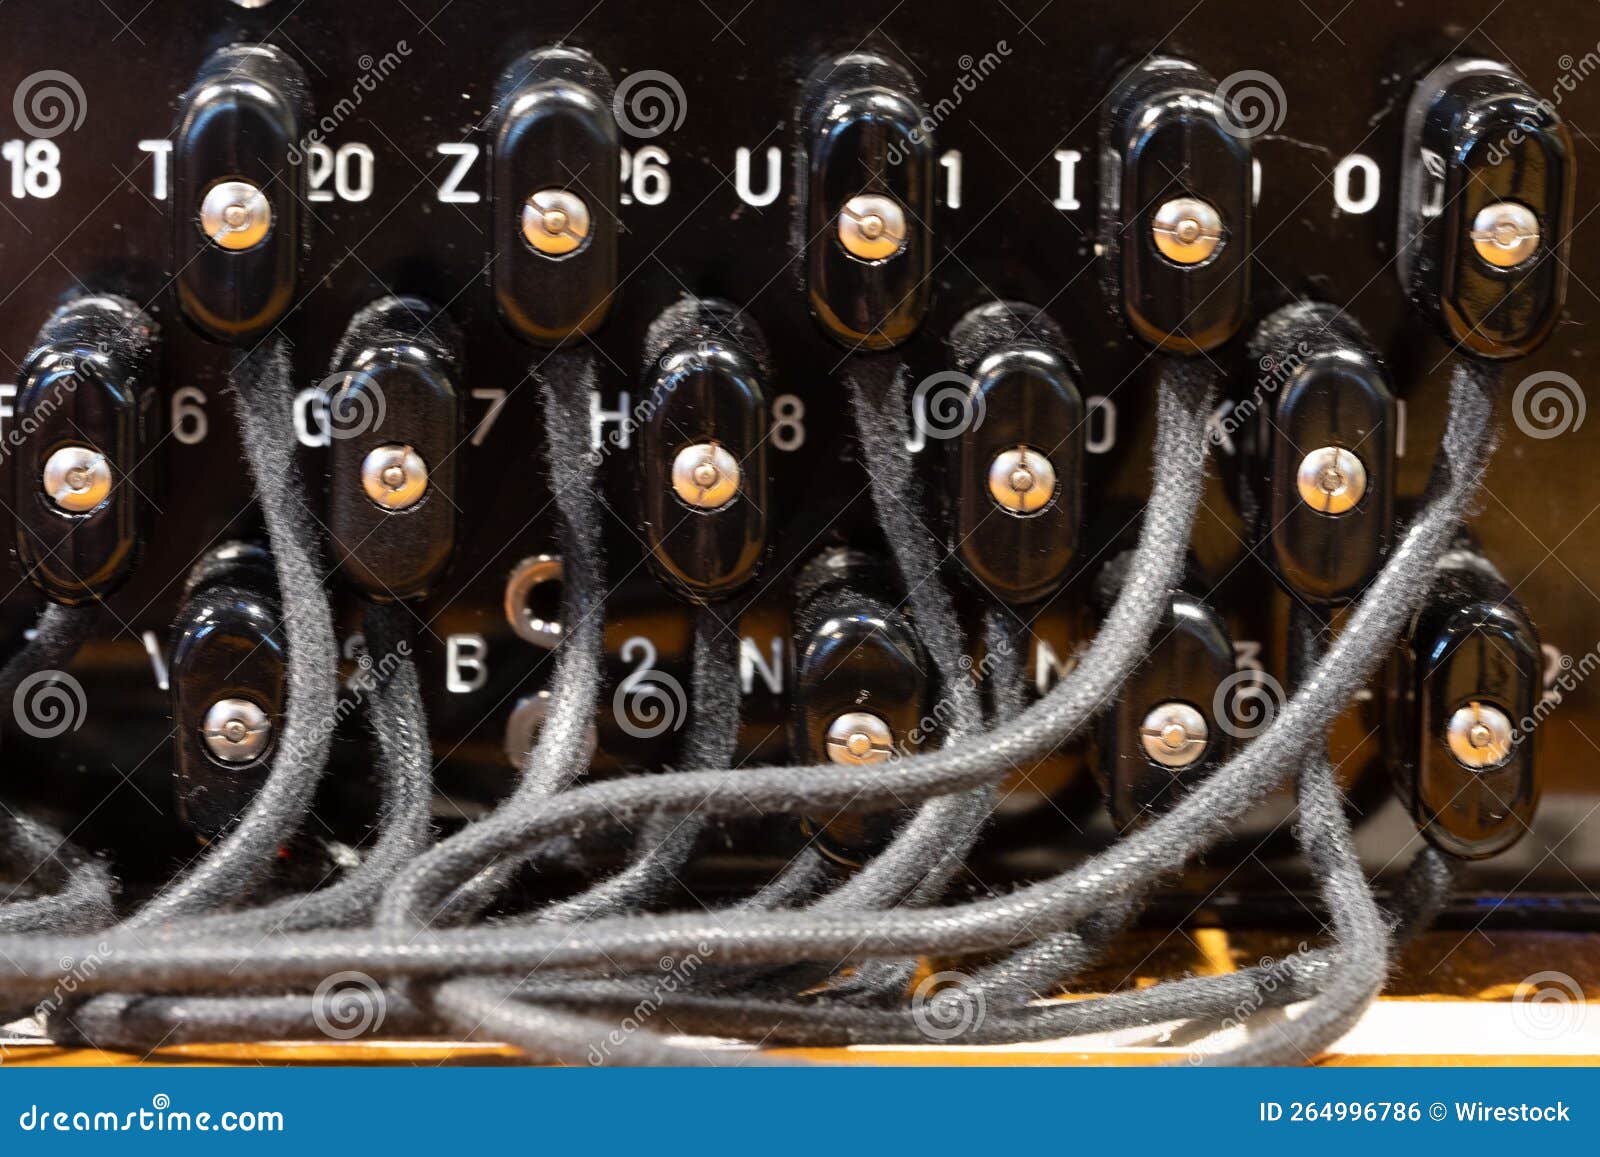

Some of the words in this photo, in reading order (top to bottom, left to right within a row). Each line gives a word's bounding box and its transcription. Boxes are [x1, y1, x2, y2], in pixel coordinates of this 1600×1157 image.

[1, 139, 62, 200] 18
[138, 139, 174, 200] T
[436, 143, 481, 203] Z
[735, 147, 782, 206] U
[1052, 150, 1081, 211] I
[171, 386, 208, 445] 6
[293, 387, 332, 447] G
[470, 388, 508, 446] 7
[589, 390, 631, 449] H
[771, 394, 805, 451] 8
[446, 633, 488, 693] B
[620, 637, 658, 694] 2
[740, 637, 783, 694] N
